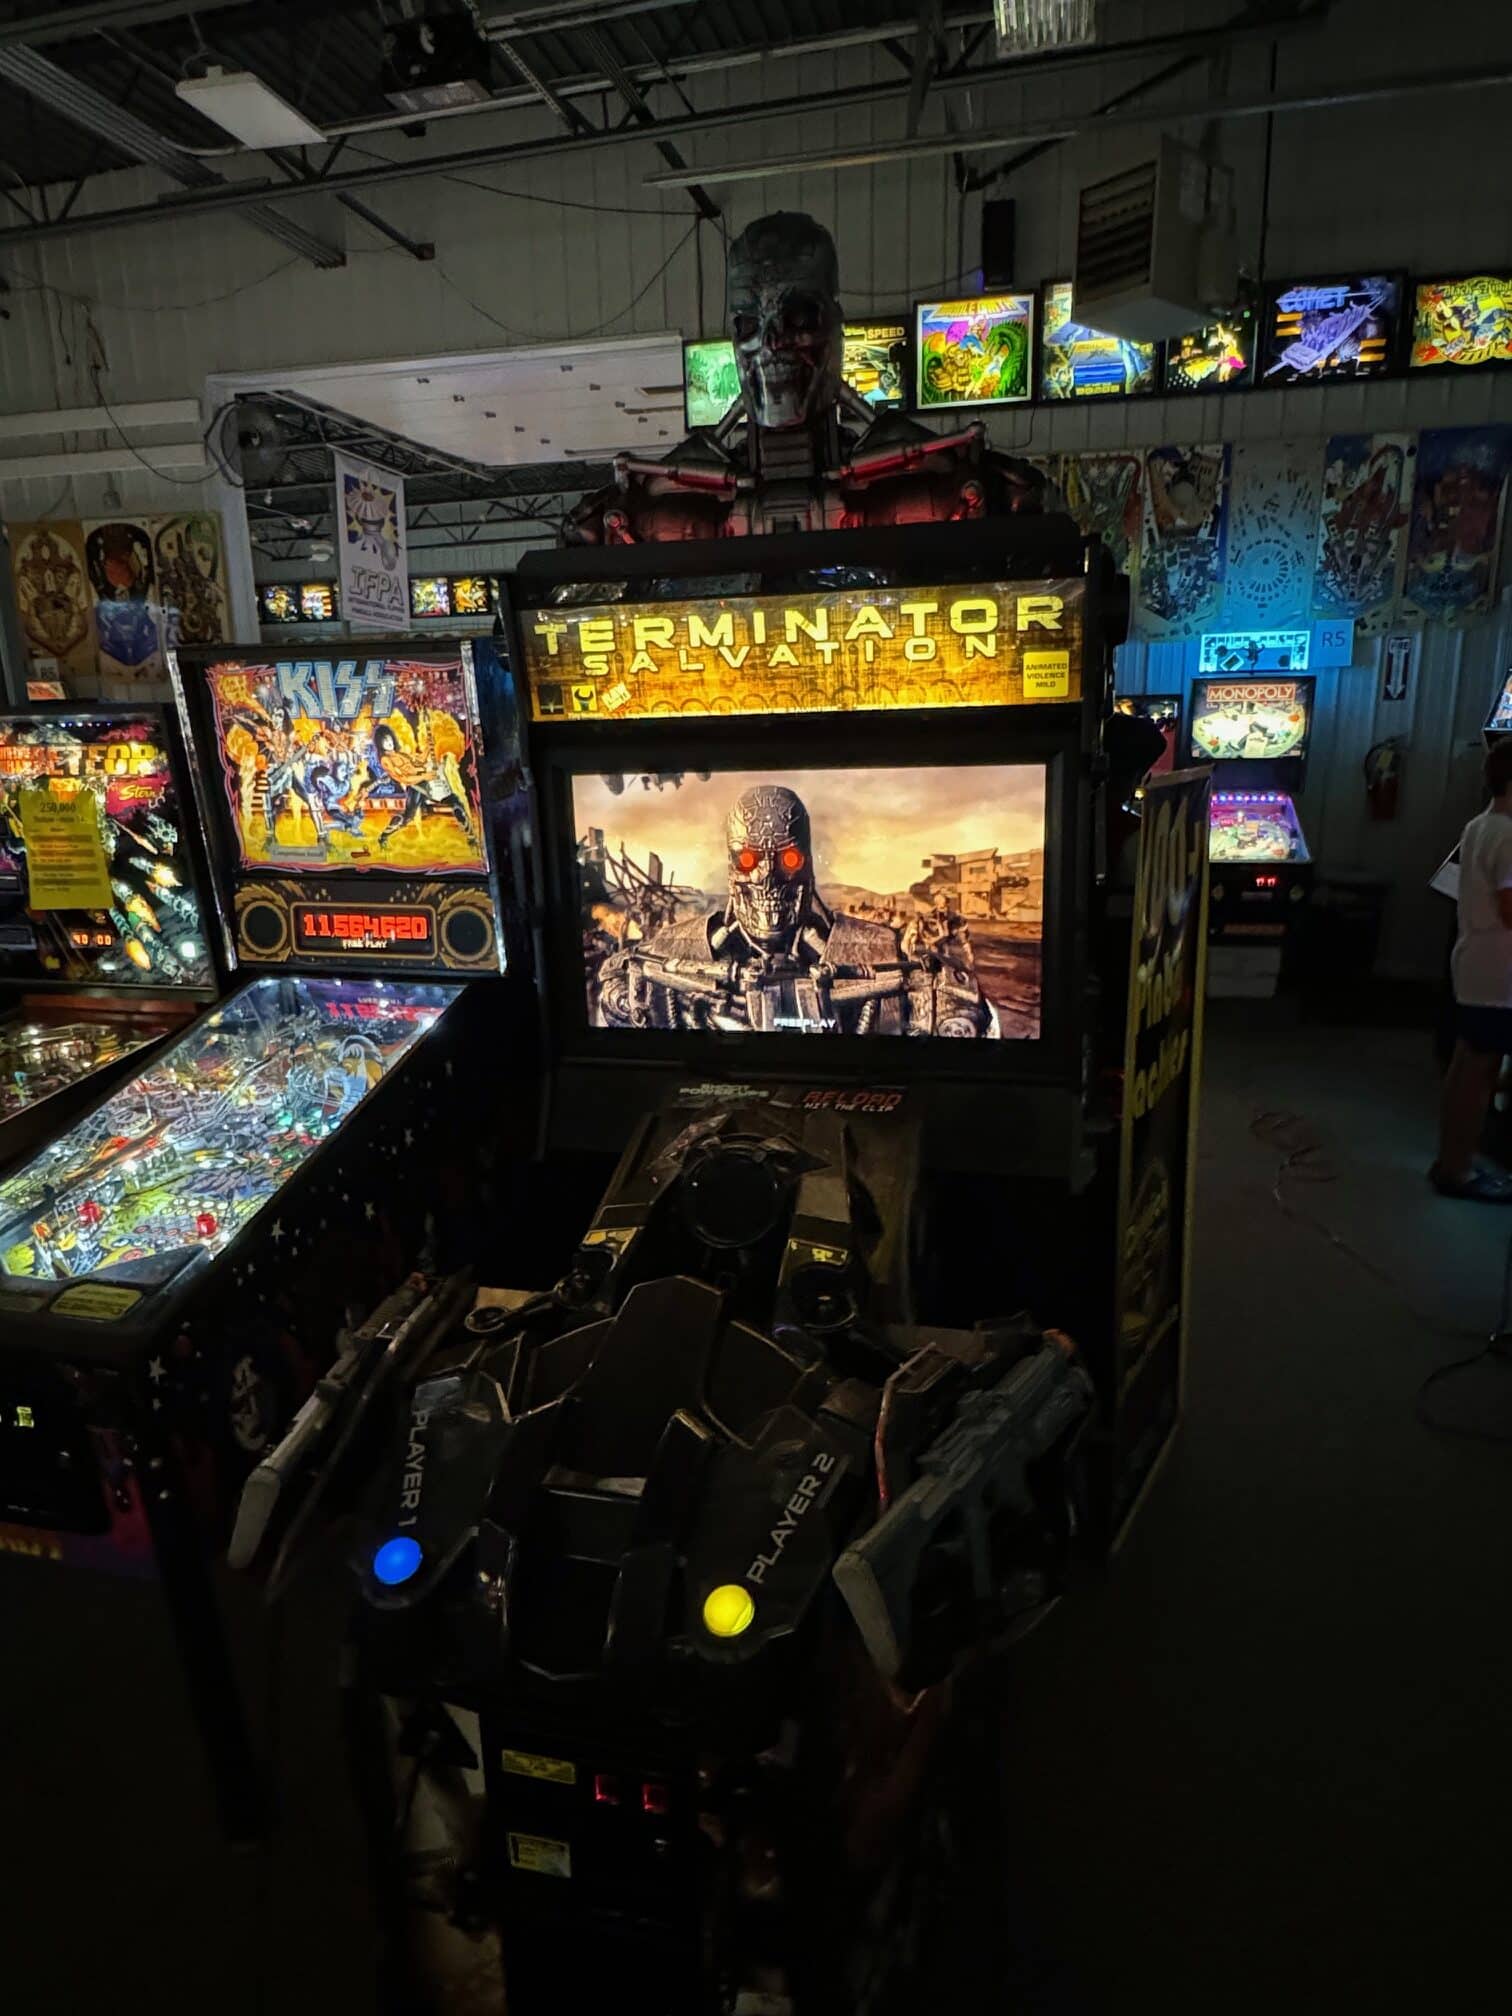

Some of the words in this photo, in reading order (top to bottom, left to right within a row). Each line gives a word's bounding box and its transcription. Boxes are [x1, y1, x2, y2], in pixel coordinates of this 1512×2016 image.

[867, 326, 905, 340] SPEED
[348, 567, 405, 606] IFPA
[534, 596, 1065, 656] TERMINATOR
[583, 634, 998, 677] SALVATION
[1025, 663, 1068, 672] ANIMATED
[1026, 672, 1066, 681] VIOLENCE
[1035, 680, 1057, 689] MILD
[276, 660, 397, 718] KISS
[1209, 686, 1293, 700] MONOPOLY
[119, 784, 156, 801] Stern
[802, 1090, 903, 1107] RELOAD
[803, 1103, 823, 1111] HIT
[834, 1103, 856, 1112] THE
[862, 1104, 895, 1113] CLIP
[401, 1409, 429, 1510] PLAYER
[397, 1514, 418, 1528] 1
[744, 1475, 823, 1586] PLAYER
[812, 1452, 839, 1475] 2
